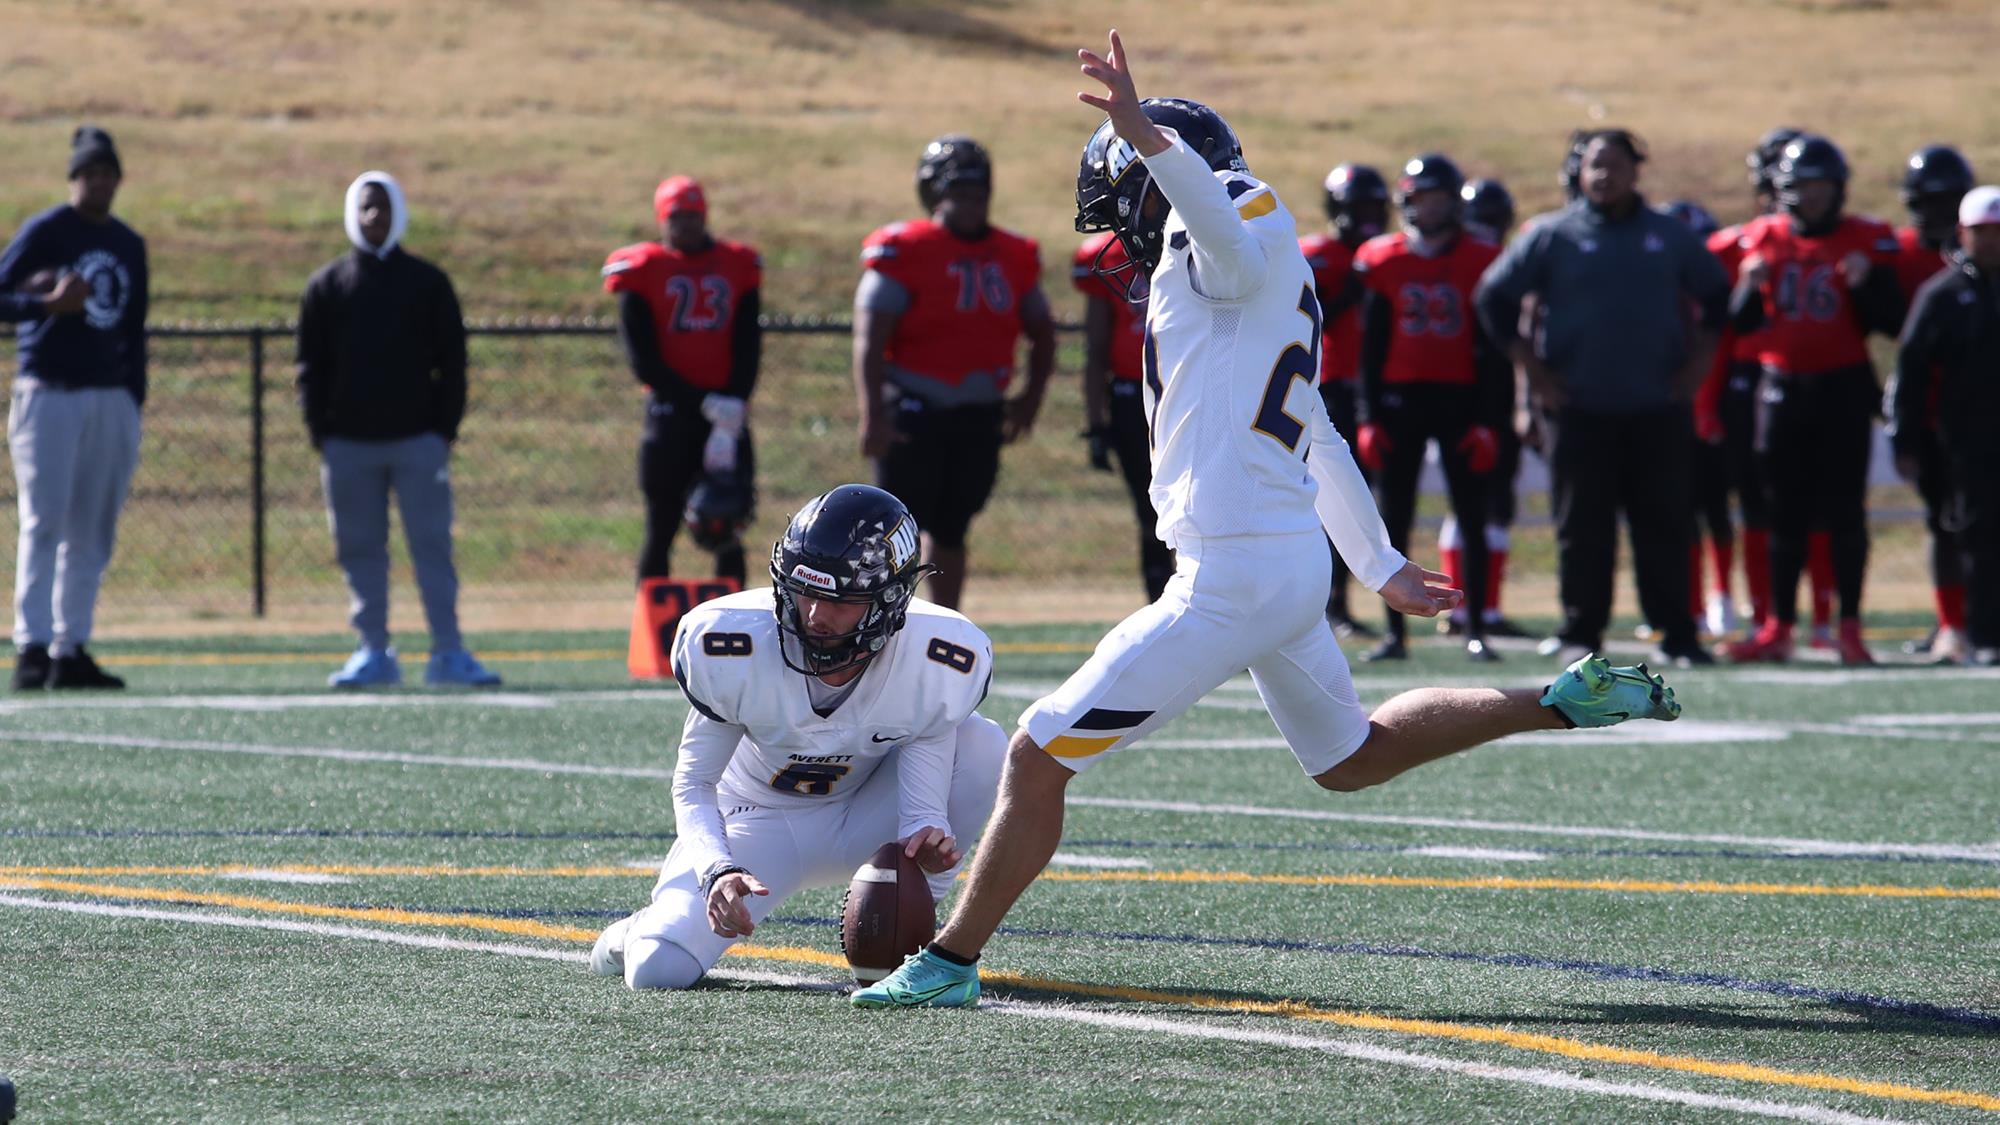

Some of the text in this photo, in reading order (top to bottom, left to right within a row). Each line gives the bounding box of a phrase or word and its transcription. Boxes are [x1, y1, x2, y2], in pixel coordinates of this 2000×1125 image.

[665, 275, 732, 331] 23
[947, 260, 1013, 313] 76
[1399, 282, 1462, 336] 33
[1250, 281, 1320, 463] 2
[887, 516, 917, 570] AU
[797, 568, 831, 586] Riddell
[703, 632, 752, 656] 8
[927, 637, 976, 674] 8
[788, 753, 854, 764] AVERETT
